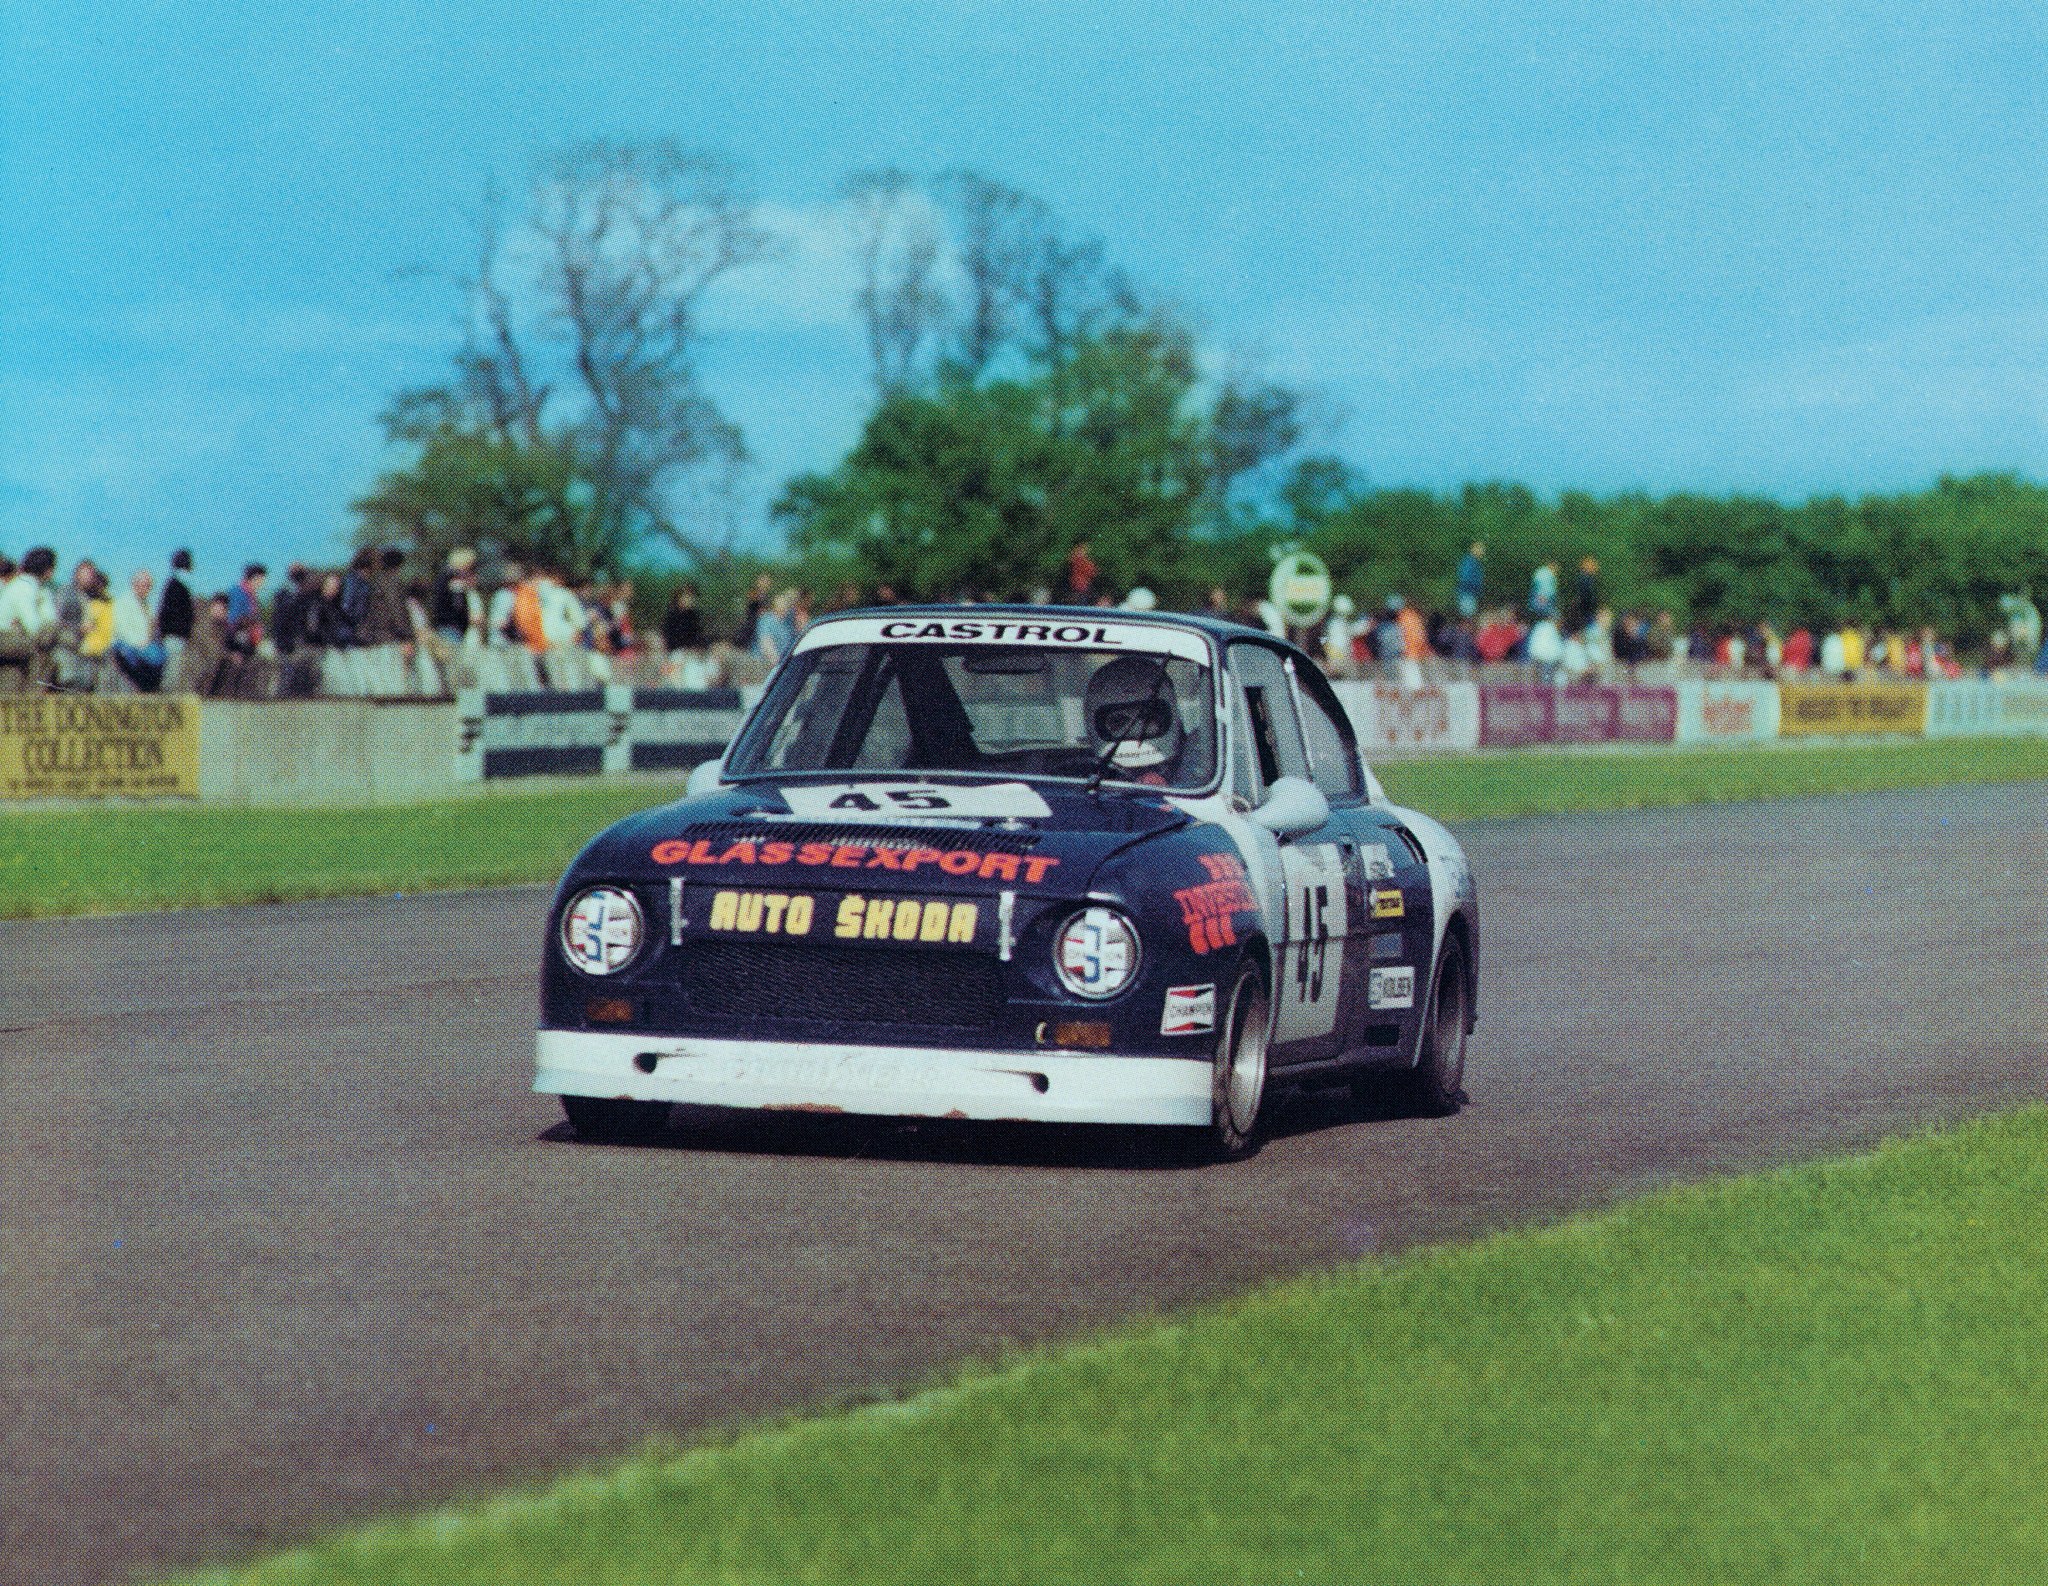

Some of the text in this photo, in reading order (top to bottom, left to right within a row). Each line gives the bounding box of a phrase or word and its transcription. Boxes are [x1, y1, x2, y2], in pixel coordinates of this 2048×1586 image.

[880, 622, 1122, 644] CASTROL
[829, 789, 951, 811] 45
[650, 838, 1060, 884] GLASSEXPORT
[709, 891, 978, 943] AUTO ŠKODA
[1296, 885, 1329, 1004] 45
